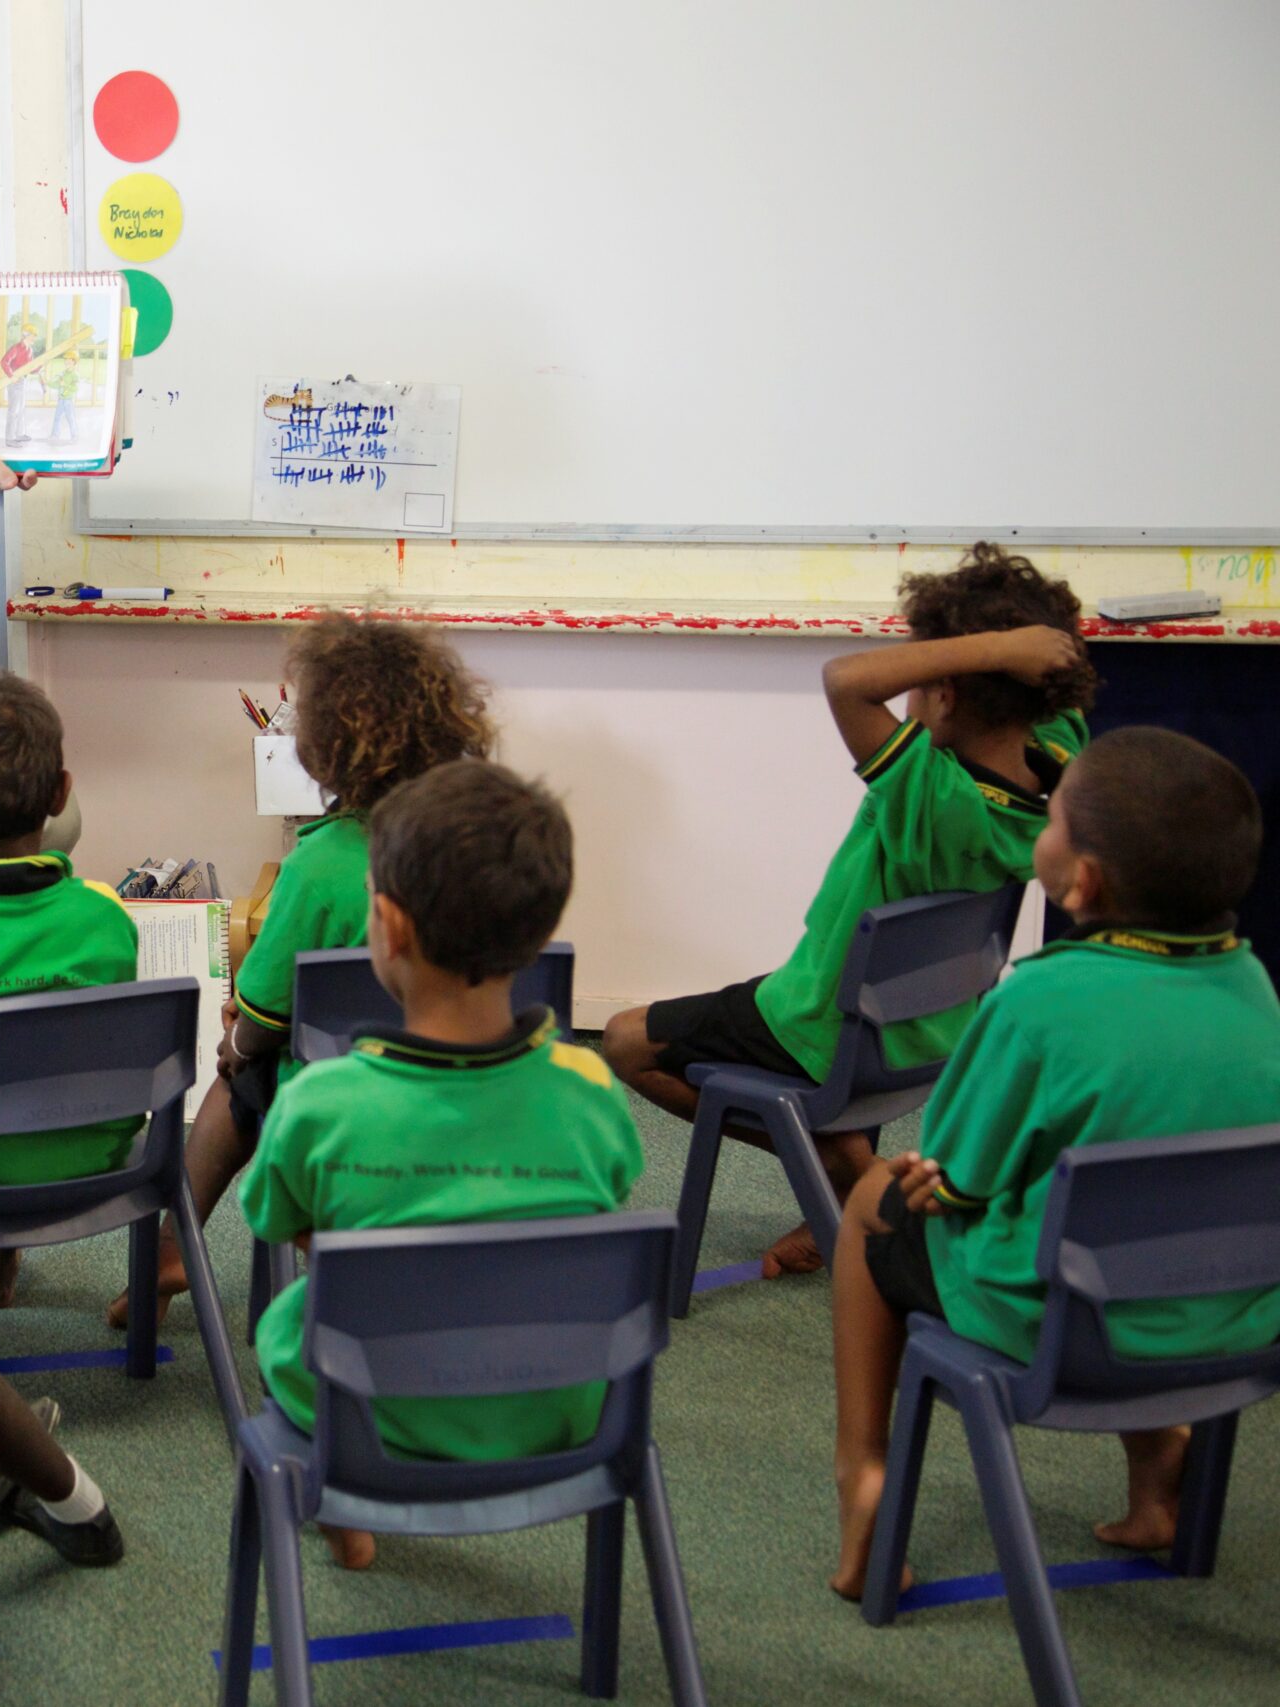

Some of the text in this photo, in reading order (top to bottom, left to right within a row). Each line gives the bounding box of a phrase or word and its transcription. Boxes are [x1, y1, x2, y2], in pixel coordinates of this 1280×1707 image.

[16, 974, 48, 988] hard.
[53, 973, 68, 985] Be
[413, 1163, 457, 1178] Work
[511, 1164, 534, 1179] Be
